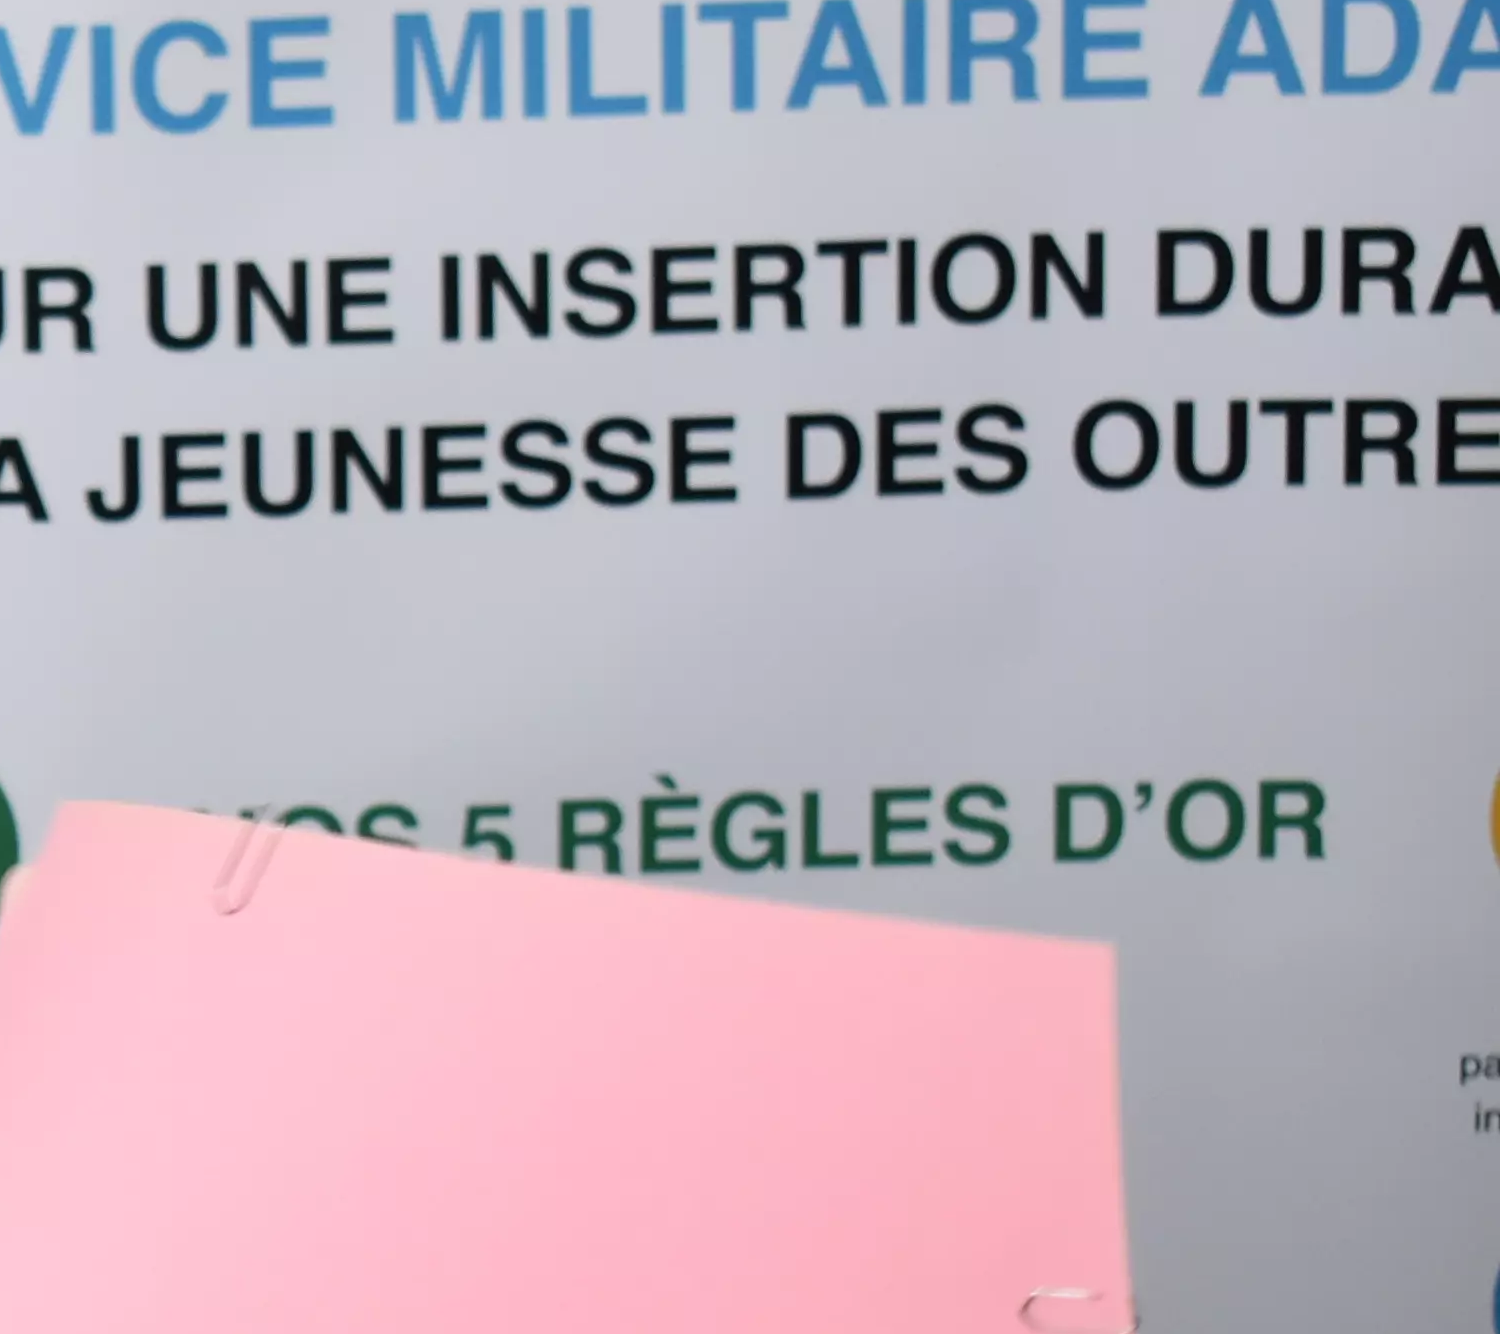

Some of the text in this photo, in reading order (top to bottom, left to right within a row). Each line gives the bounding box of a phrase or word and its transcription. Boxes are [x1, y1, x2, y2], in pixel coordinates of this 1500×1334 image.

[145, 256, 396, 351] UNE
[440, 231, 1106, 342] INSERTION
[1154, 224, 1500, 318] DURA
[86, 415, 739, 523] JEUNESSE
[784, 402, 1030, 500] DES
[1072, 395, 1500, 492] OUTRE
[462, 804, 515, 863] 5
[558, 773, 1012, 874] RÈGLES
[1053, 778, 1327, 862] D’OR
